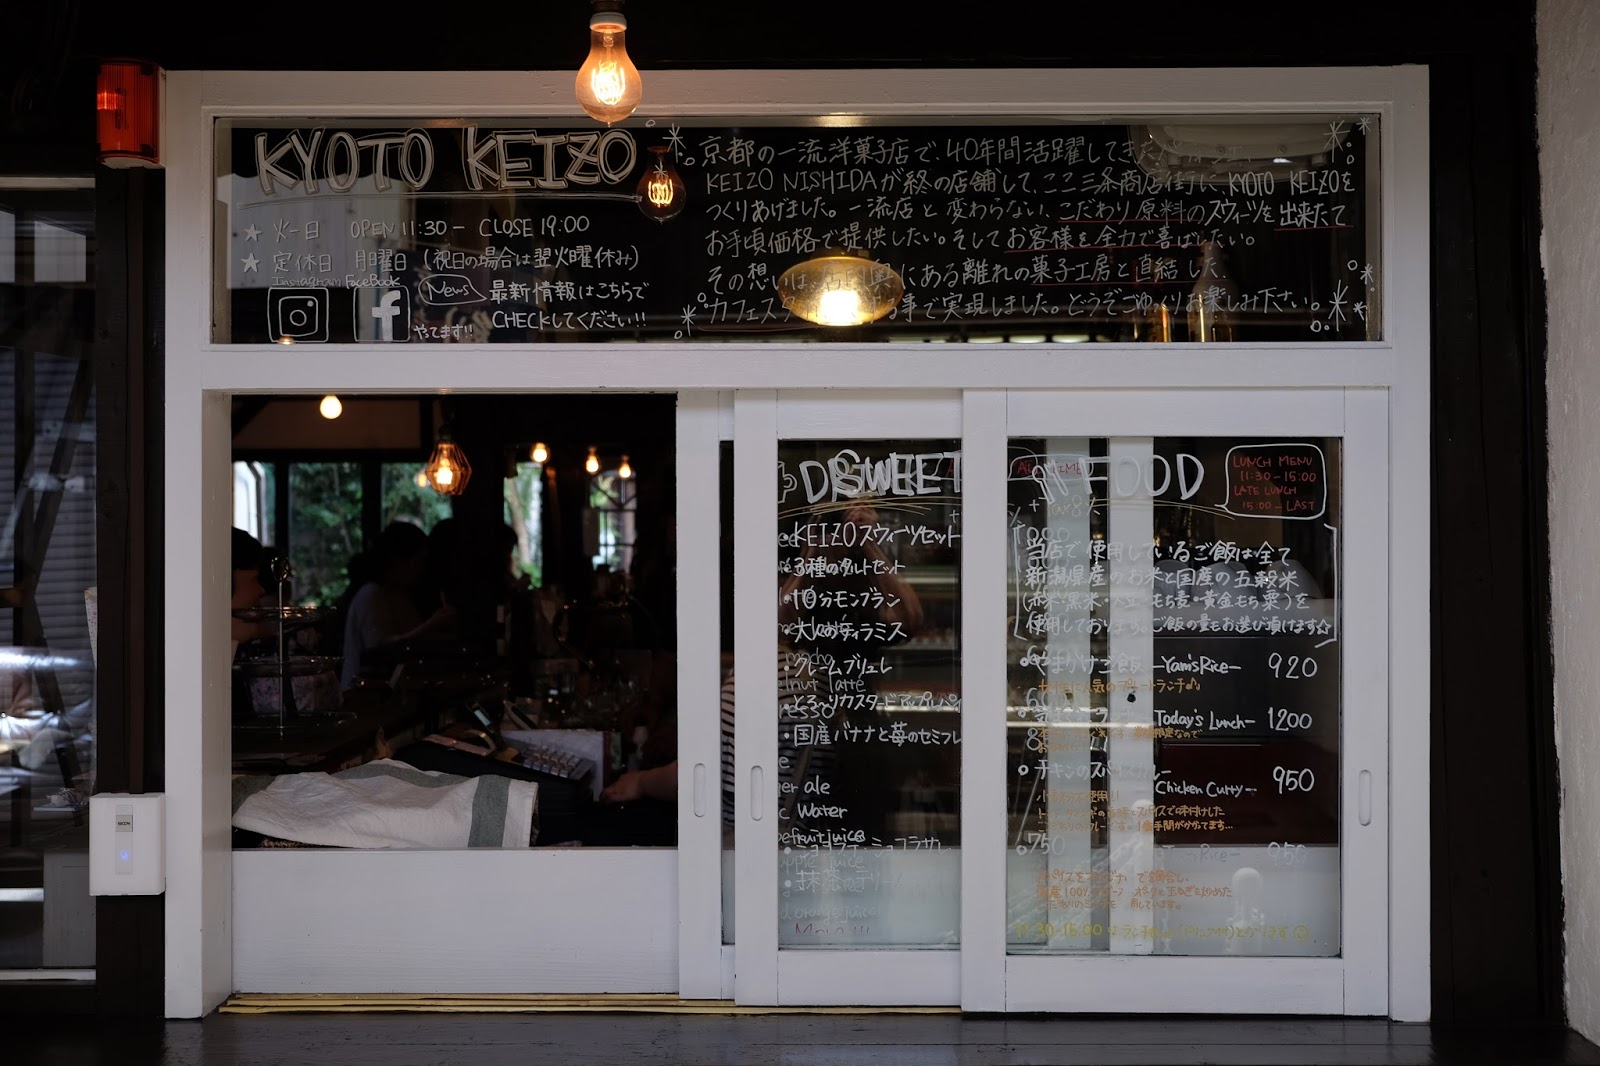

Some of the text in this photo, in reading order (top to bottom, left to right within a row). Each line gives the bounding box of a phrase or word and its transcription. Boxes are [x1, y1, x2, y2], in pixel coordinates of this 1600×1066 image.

[255, 124, 637, 195] KYOTO KEIZO
[706, 168, 774, 194] KEIZO
[350, 219, 395, 239] OPEN
[402, 219, 447, 238] 11:30
[478, 217, 533, 238] CLOSE
[541, 215, 590, 237] 19:00
[273, 251, 333, 273] 定休日
[355, 248, 407, 273] 月曜日
[428, 281, 471, 303] News
[488, 280, 649, 305] 最新情報はこちらで
[1233, 455, 1313, 468] LUNCH MENU
[1079, 454, 1205, 500] FOOD
[1240, 471, 1271, 482] 11:30
[1284, 470, 1317, 483] 15:00
[1234, 485, 1297, 496] LATE LUNCH
[1243, 501, 1272, 511] 15:00
[1286, 499, 1315, 512] LAST
[1267, 651, 1317, 679] 920
[1267, 707, 1312, 731] 1200
[804, 775, 831, 795] ale
[1155, 780, 1203, 795] Chicken
[1273, 766, 1315, 793] 950
[797, 803, 848, 819] Water
